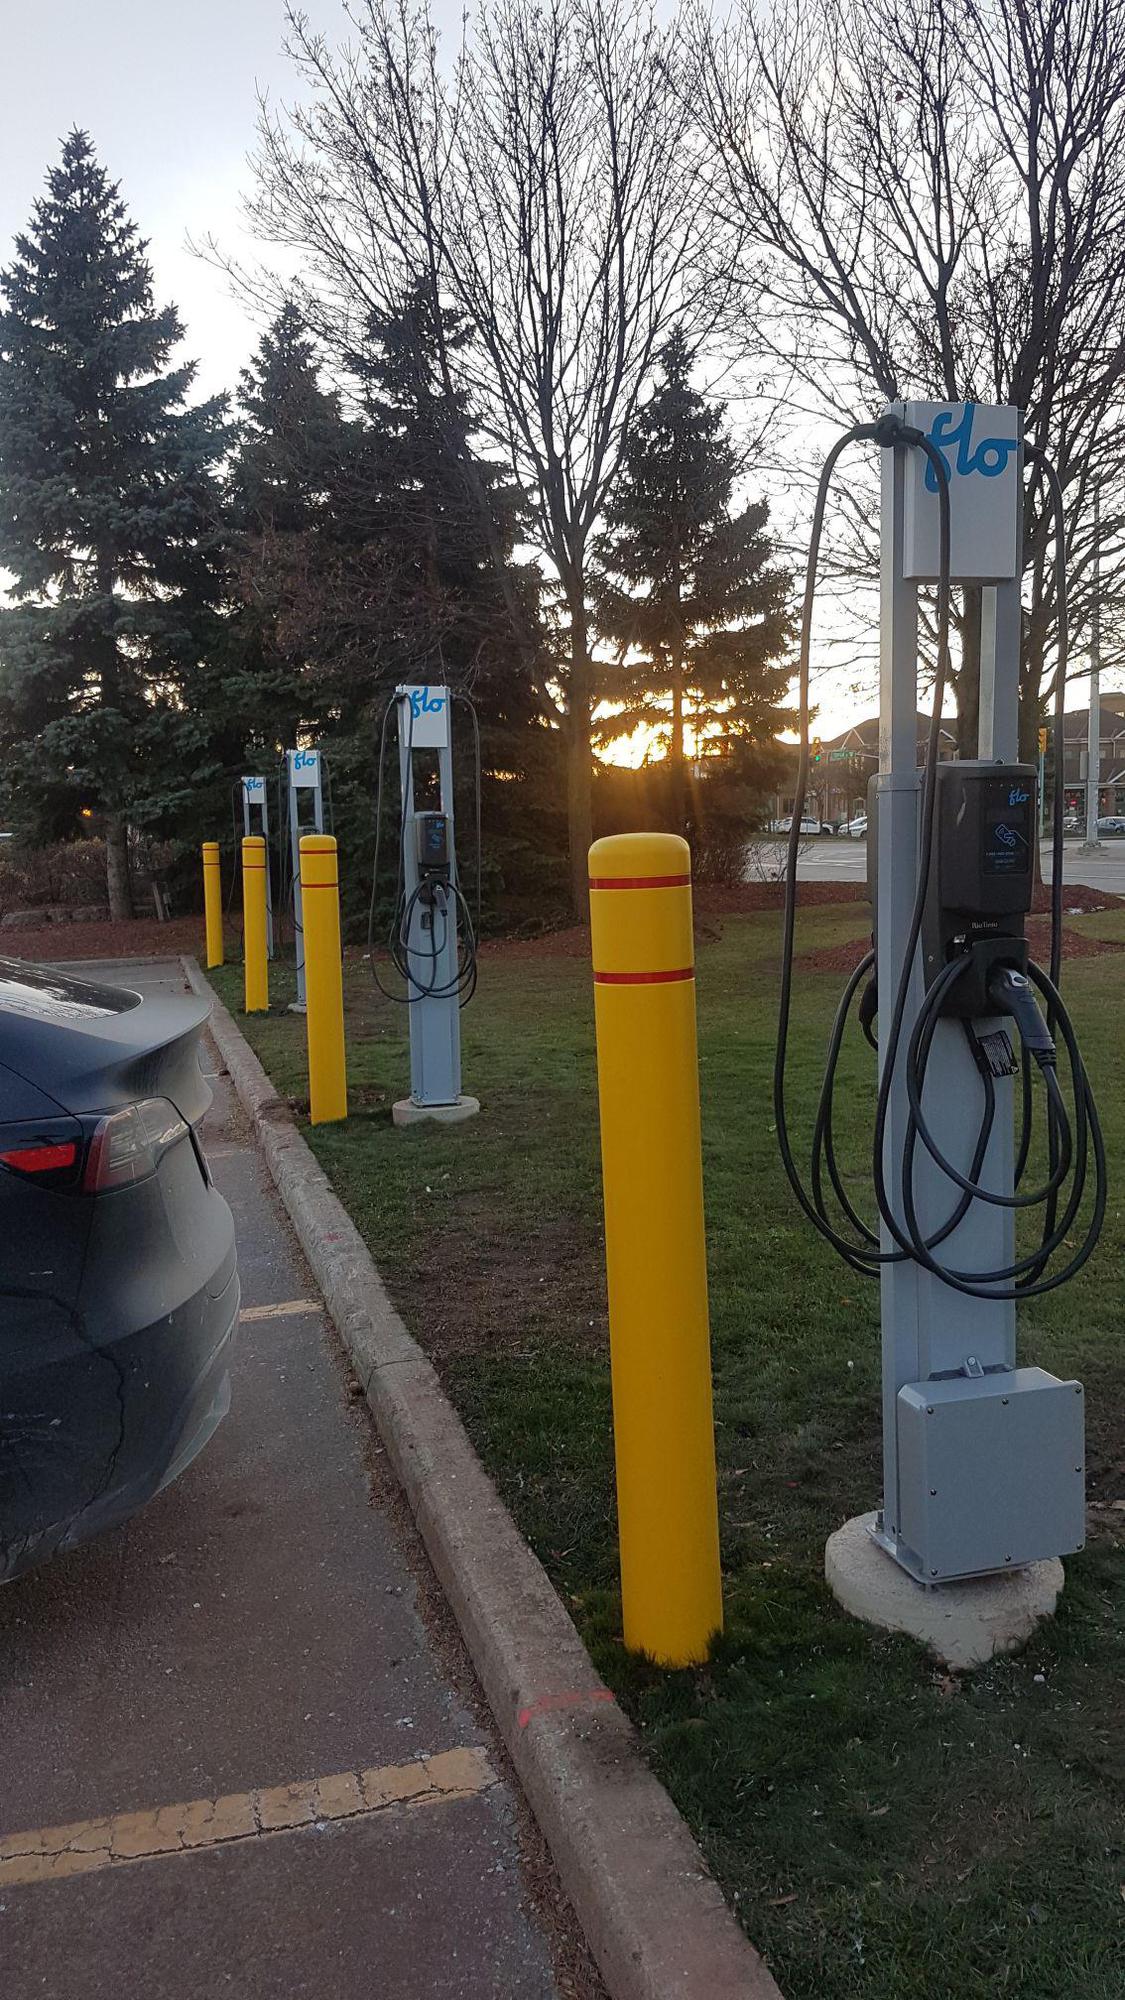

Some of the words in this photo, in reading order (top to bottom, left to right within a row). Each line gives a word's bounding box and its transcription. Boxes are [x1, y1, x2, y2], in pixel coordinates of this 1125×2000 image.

[925, 401, 1017, 493] flo
[411, 686, 446, 719] flo
[294, 751, 317, 770] flo
[246, 777, 264, 792] flo
[1008, 788, 1030, 806] flo
